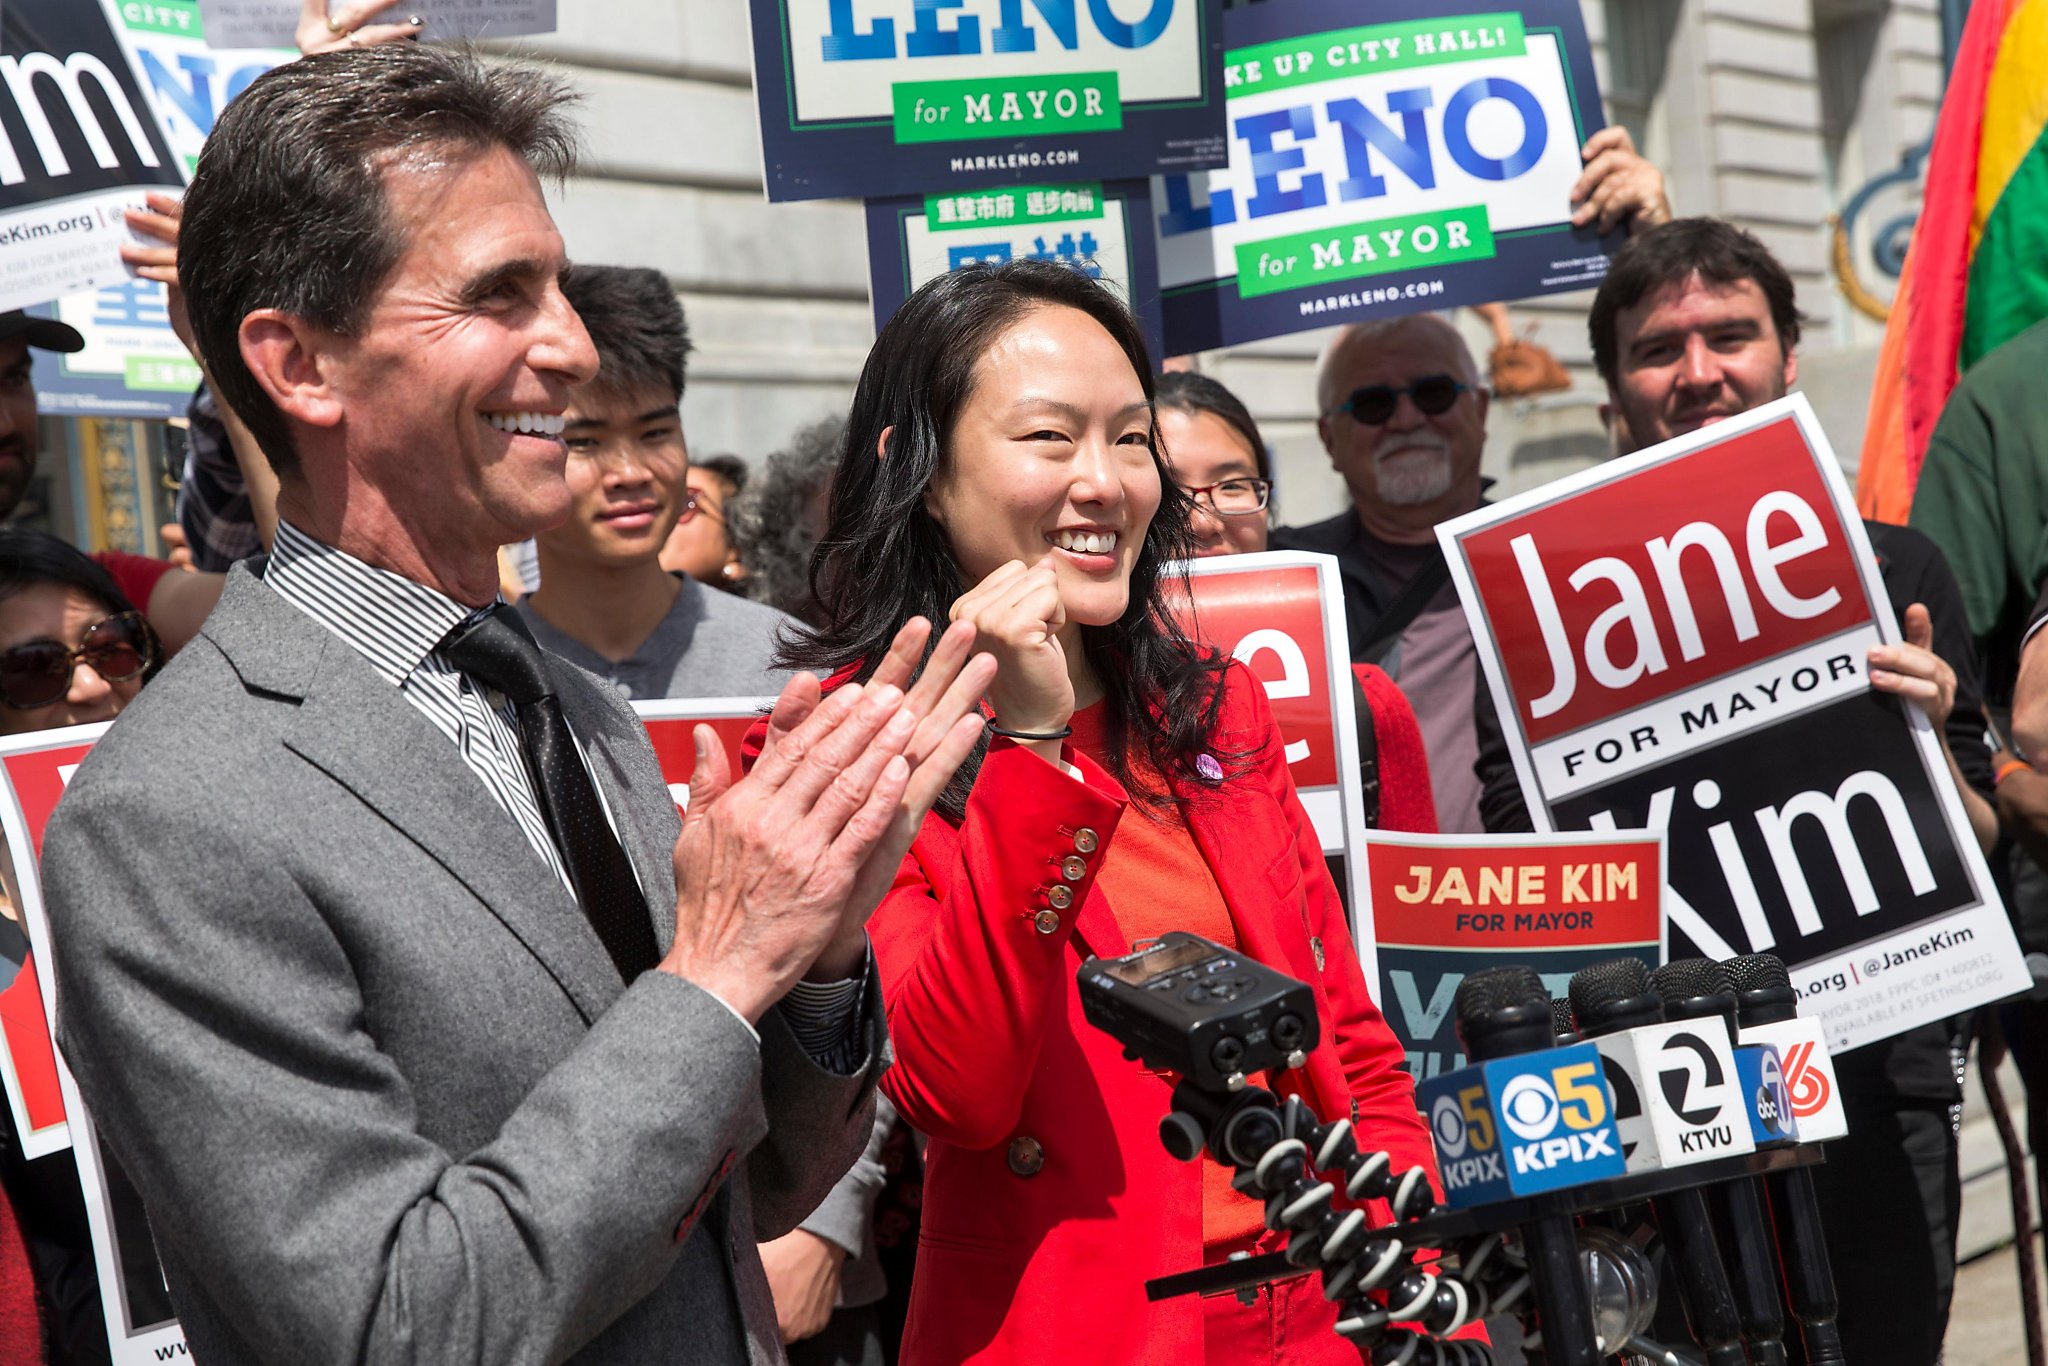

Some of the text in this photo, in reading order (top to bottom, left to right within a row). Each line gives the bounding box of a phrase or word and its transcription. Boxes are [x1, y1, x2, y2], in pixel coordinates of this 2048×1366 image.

[123, 2, 192, 30] CITY
[1273, 51, 1314, 76] UP
[1326, 37, 1401, 66] CITY
[1414, 27, 1506, 55] HALL!
[913, 87, 1103, 124] for MAYOR
[951, 150, 1079, 172] MARKLENO.COM
[1159, 76, 1547, 238] LENO
[1258, 220, 1472, 278] for MAYOR
[1300, 279, 1444, 316] MARKLENO.COM
[1509, 489, 1843, 721] Jane
[1562, 653, 1857, 777] FOR MAYOR
[1394, 861, 1638, 906] JANE KIM
[1455, 911, 1594, 932] FOR MAYOR
[1863, 926, 1974, 978] @JaneKim
[1458, 1084, 1496, 1151] 5
[1551, 1061, 1607, 1131] 5
[1757, 1097, 1778, 1120] abc
[1512, 1128, 1617, 1175] KPIX
[1679, 1125, 1732, 1153] KTVU
[1442, 1153, 1505, 1190] KPIX
